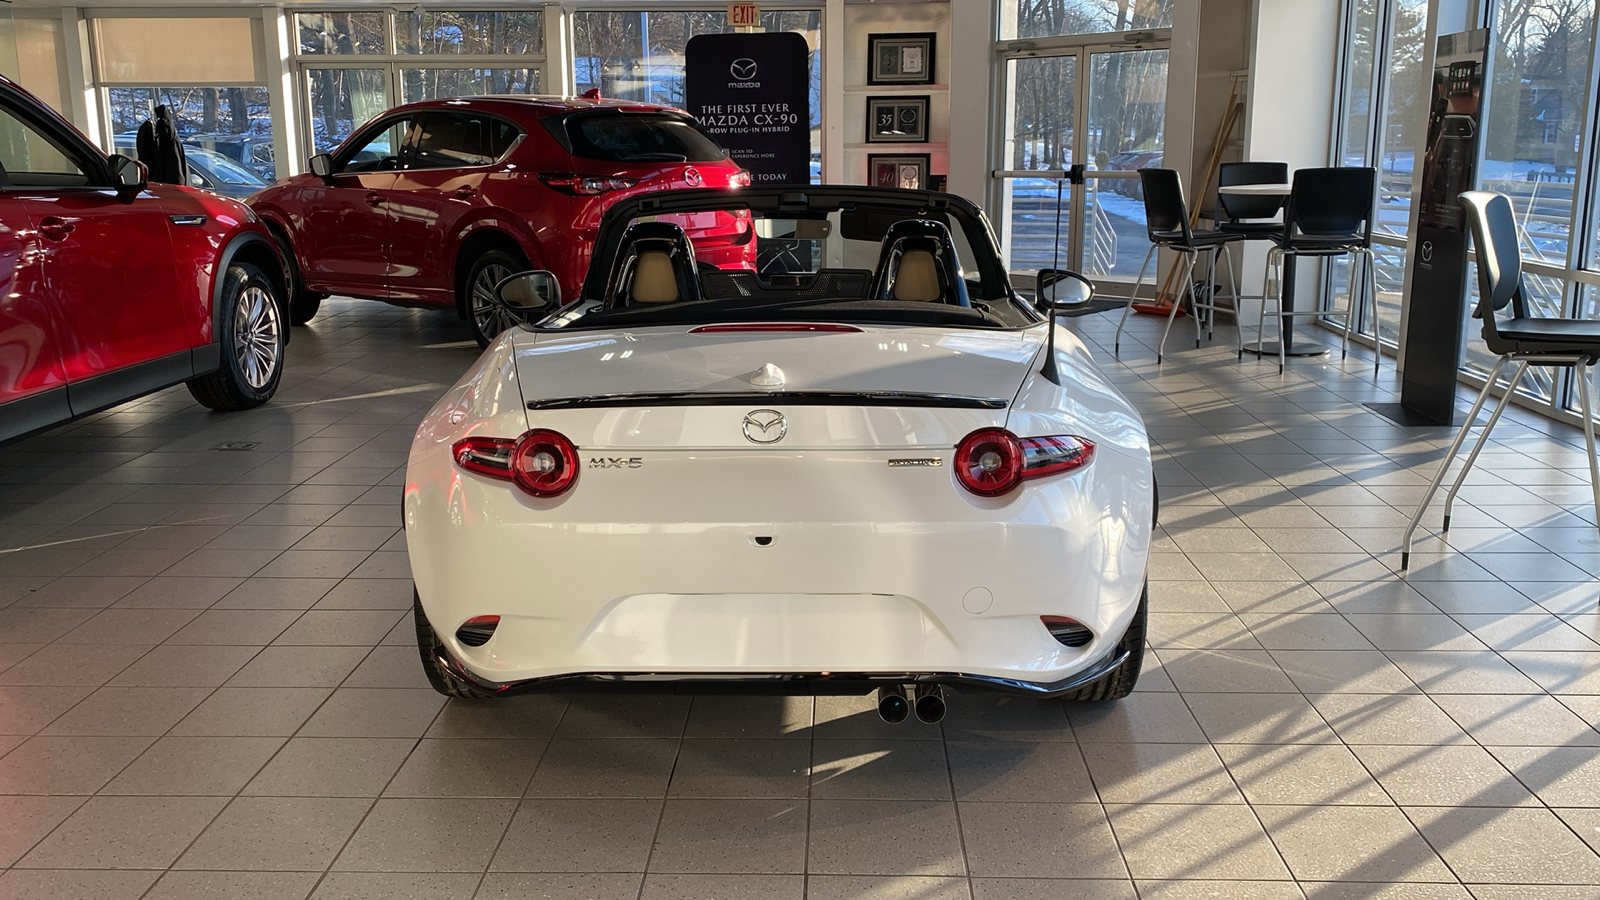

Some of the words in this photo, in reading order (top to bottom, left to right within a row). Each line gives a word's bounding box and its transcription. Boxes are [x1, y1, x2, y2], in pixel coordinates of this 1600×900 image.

[733, 5, 755, 23] EXIT
[701, 105, 722, 114] THE
[727, 104, 757, 113] FIRST
[761, 103, 789, 112] EVER
[695, 115, 748, 126] MAZDA
[754, 113, 797, 125] CX-90
[878, 114, 892, 126] 35
[880, 173, 894, 183] 40
[589, 457, 643, 469] MX-5
